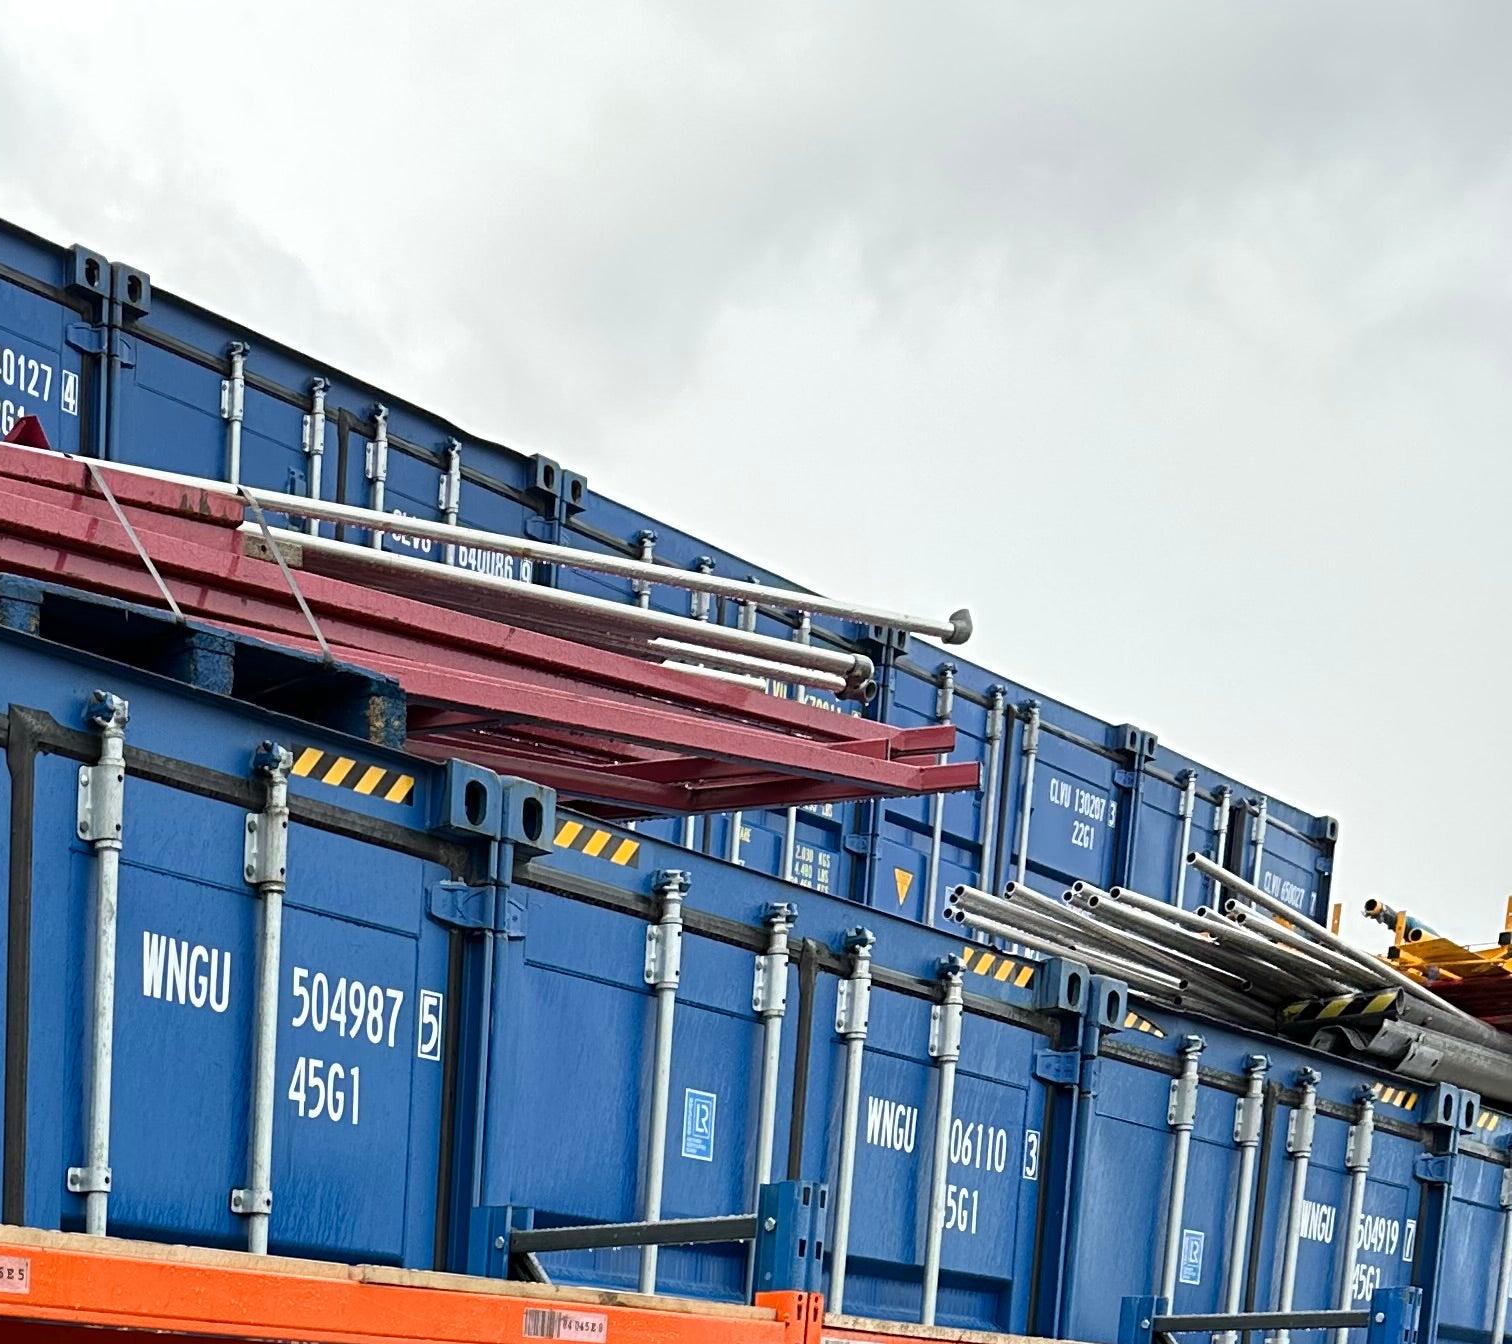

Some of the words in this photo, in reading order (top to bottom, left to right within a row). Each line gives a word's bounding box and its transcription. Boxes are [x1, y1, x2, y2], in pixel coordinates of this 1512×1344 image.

[63, 371, 78, 415] 4
[1050, 778, 1071, 808] CLVU
[143, 931, 231, 1013] WNGU
[292, 966, 403, 1047] 504987
[420, 994, 441, 1057] 5
[288, 1056, 359, 1125] 45G1
[867, 1096, 918, 1153] WNGU
[950, 1118, 1007, 1173] 06110
[1025, 1131, 1039, 1179] 3
[941, 1184, 979, 1234] 5G1
[1300, 1199, 1336, 1244] WNGU
[1404, 1221, 1415, 1260] 7
